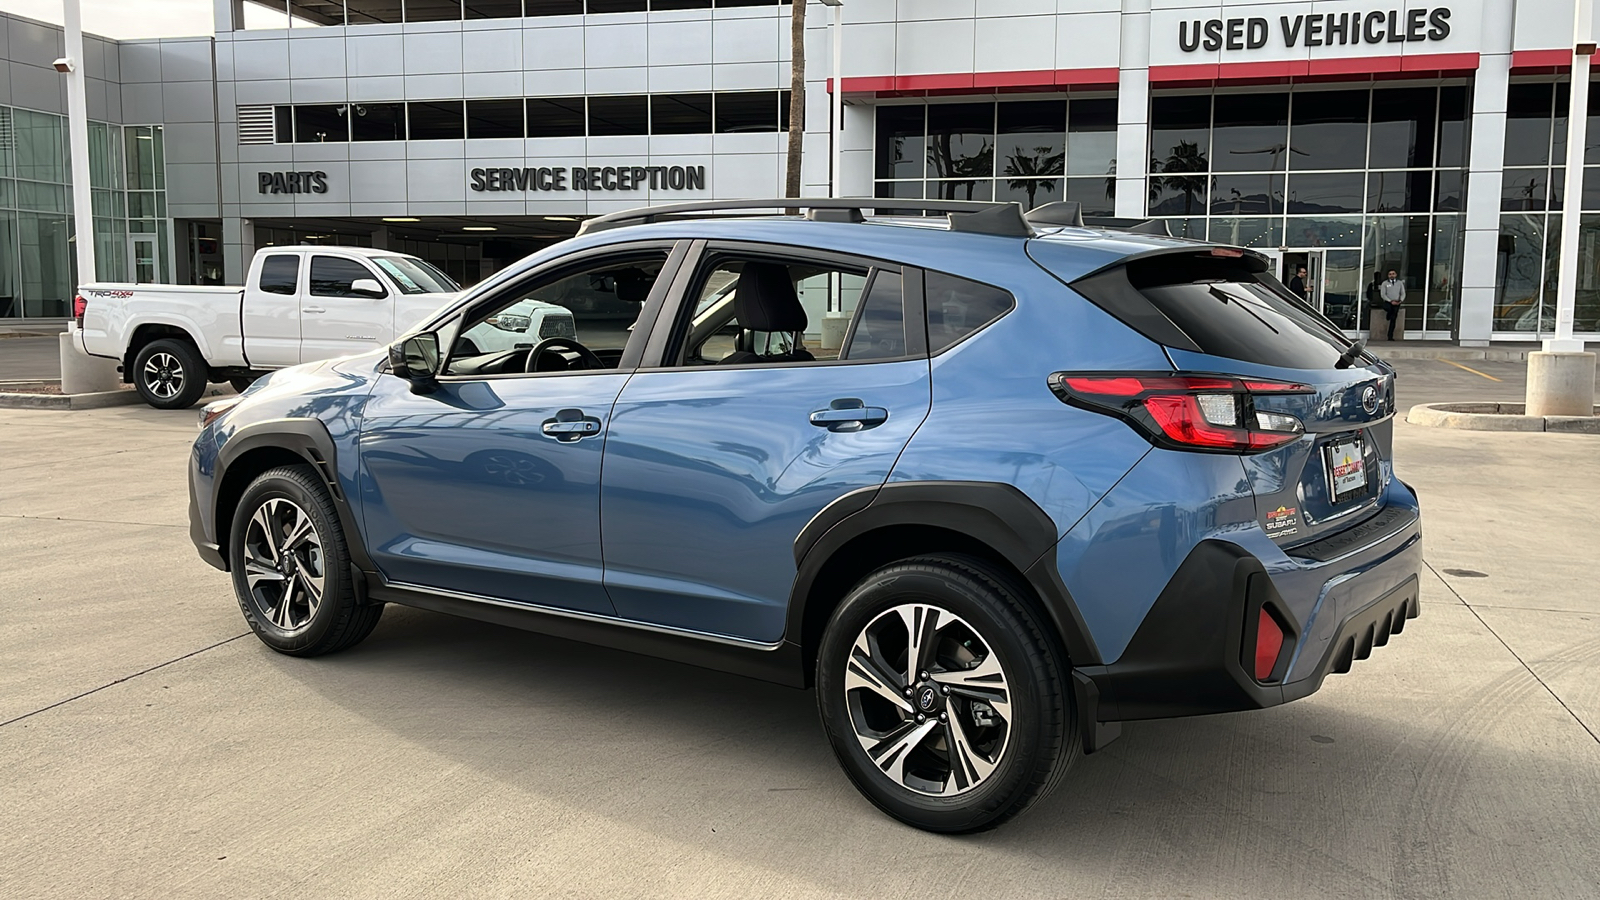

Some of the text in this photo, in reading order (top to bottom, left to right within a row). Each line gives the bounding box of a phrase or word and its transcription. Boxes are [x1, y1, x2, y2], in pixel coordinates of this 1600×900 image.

[1179, 7, 1451, 52] USED VEHICLES
[258, 170, 329, 194] PARTS
[470, 165, 705, 192] SERVICE RECEPTION
[1266, 518, 1297, 530] SUBARU
